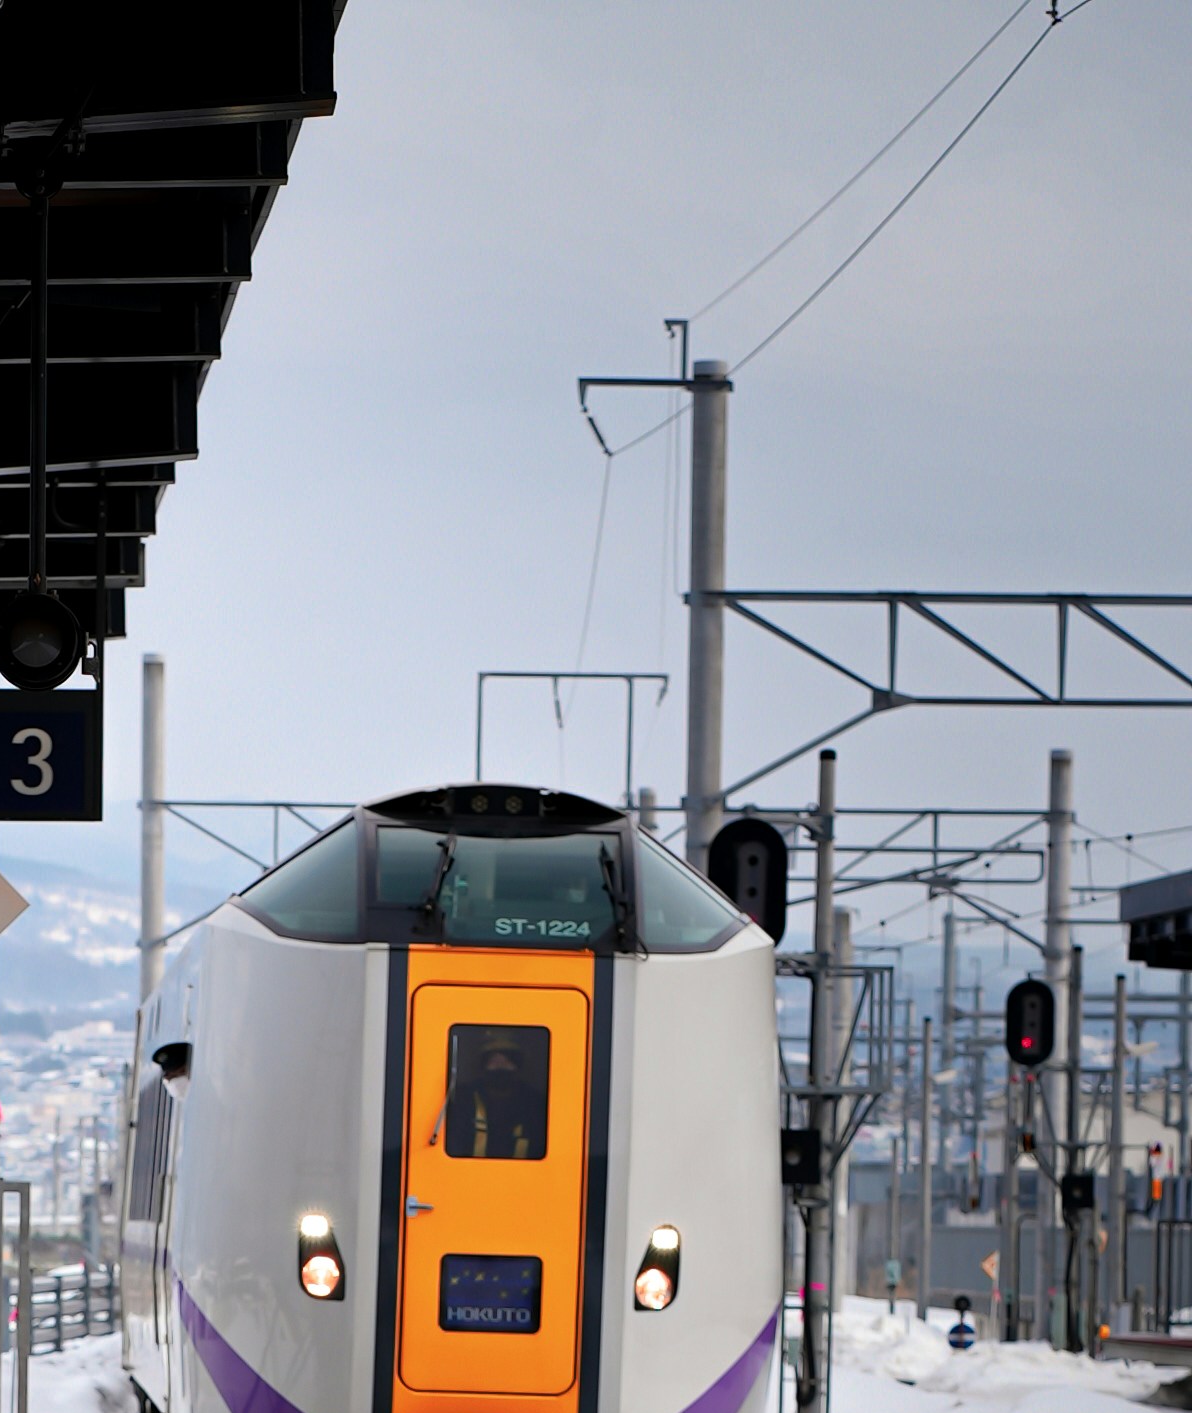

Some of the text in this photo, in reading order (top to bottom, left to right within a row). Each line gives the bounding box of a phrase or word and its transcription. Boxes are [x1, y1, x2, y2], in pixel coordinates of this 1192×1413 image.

[11, 728, 53, 795] 3
[495, 917, 591, 937] ST-1224
[447, 1306, 531, 1323] HOKUTO
